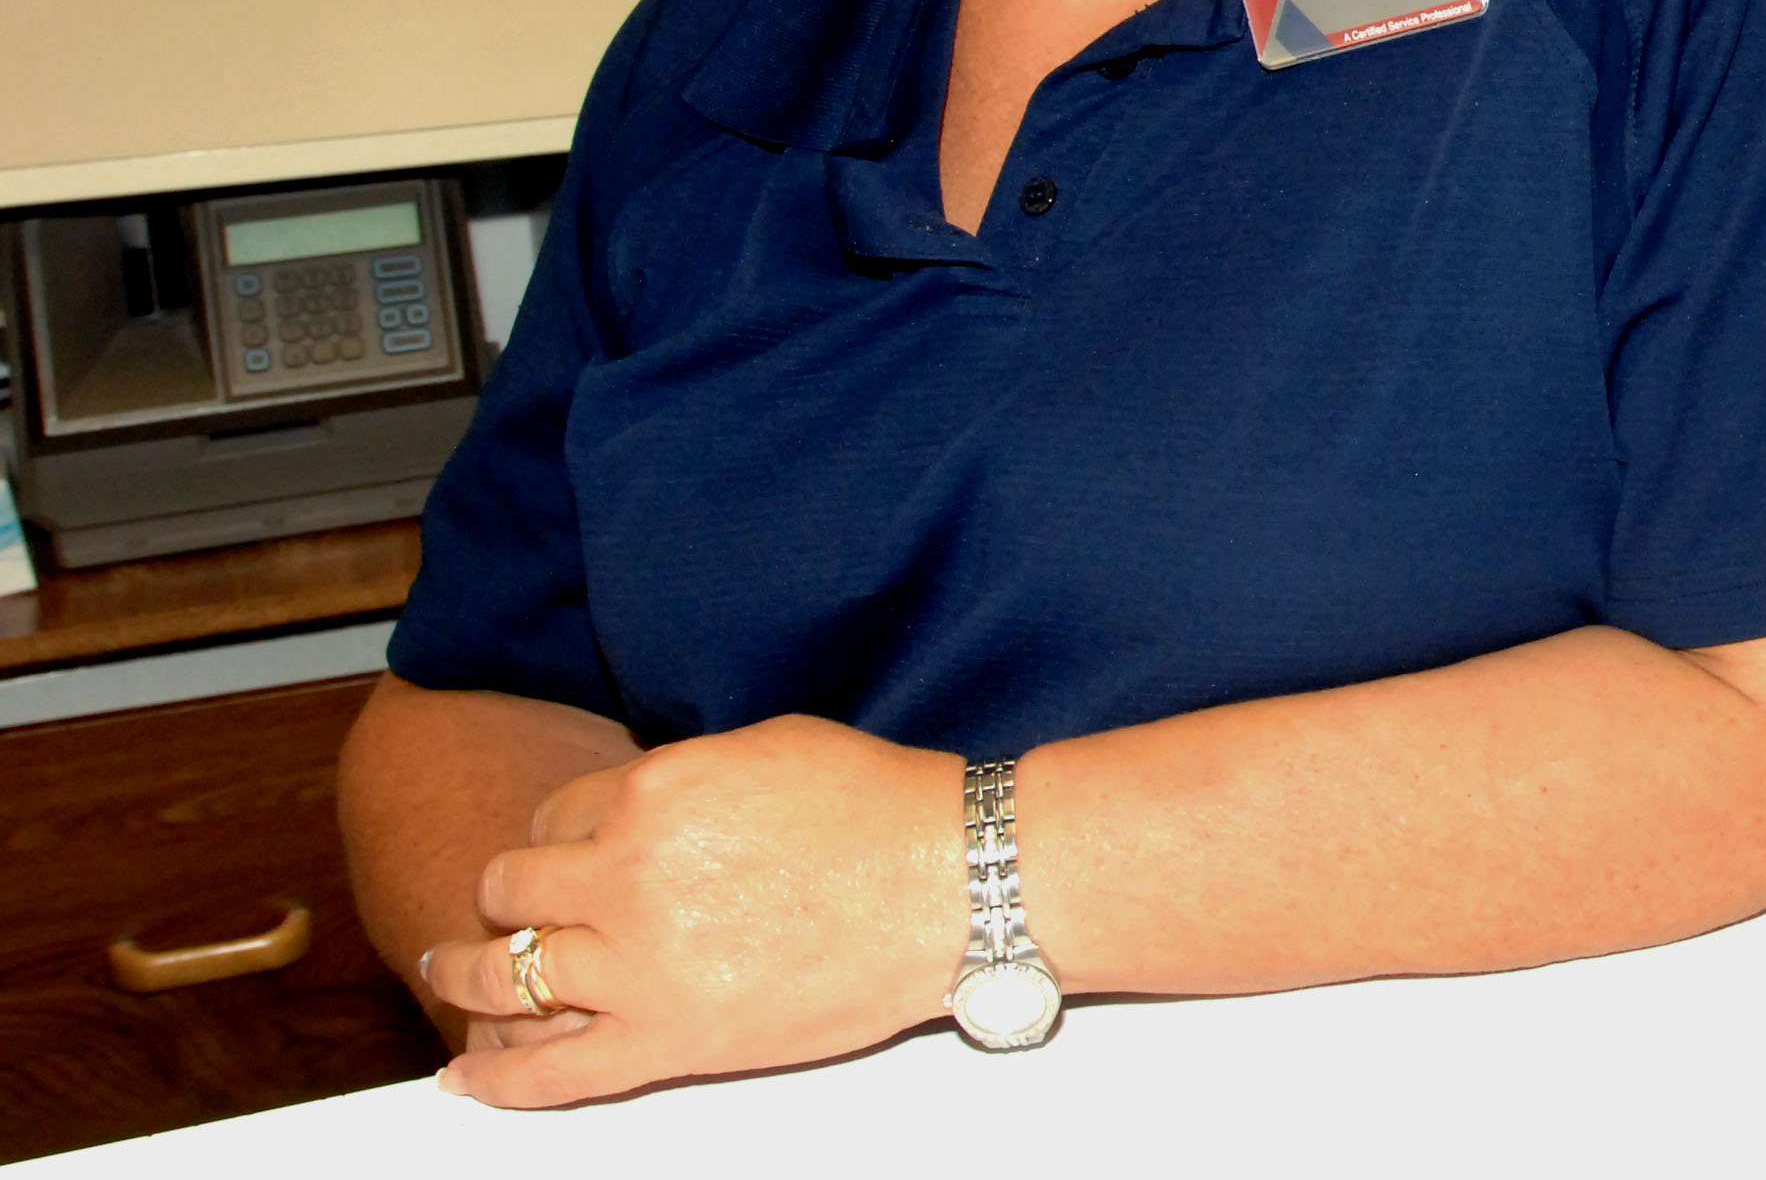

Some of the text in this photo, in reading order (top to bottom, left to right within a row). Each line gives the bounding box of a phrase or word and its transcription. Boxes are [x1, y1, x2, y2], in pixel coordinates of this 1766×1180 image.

[1344, 0, 1473, 43] A Certified Service Professional
